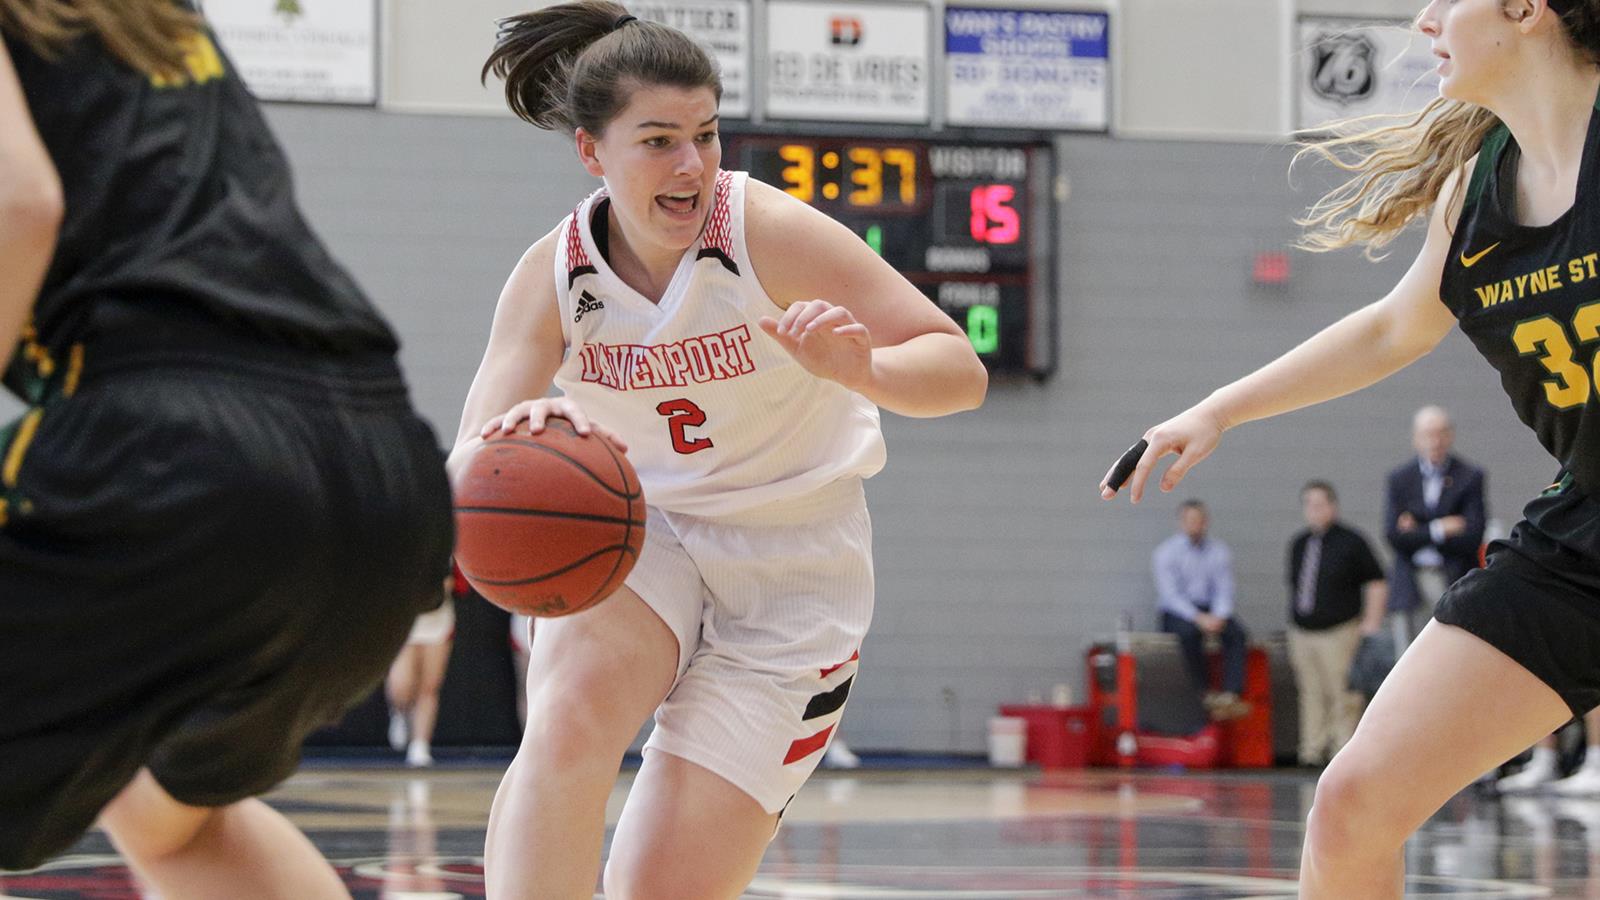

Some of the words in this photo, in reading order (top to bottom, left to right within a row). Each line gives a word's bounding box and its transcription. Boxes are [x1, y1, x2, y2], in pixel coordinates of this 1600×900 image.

[780, 145, 916, 206] 3:37
[928, 148, 1026, 179] VISITOR
[970, 184, 1020, 244] 15
[1474, 264, 1563, 309] WAYNE
[579, 324, 755, 390] DAVENPORT
[967, 305, 998, 354] 0
[656, 398, 714, 454] 2
